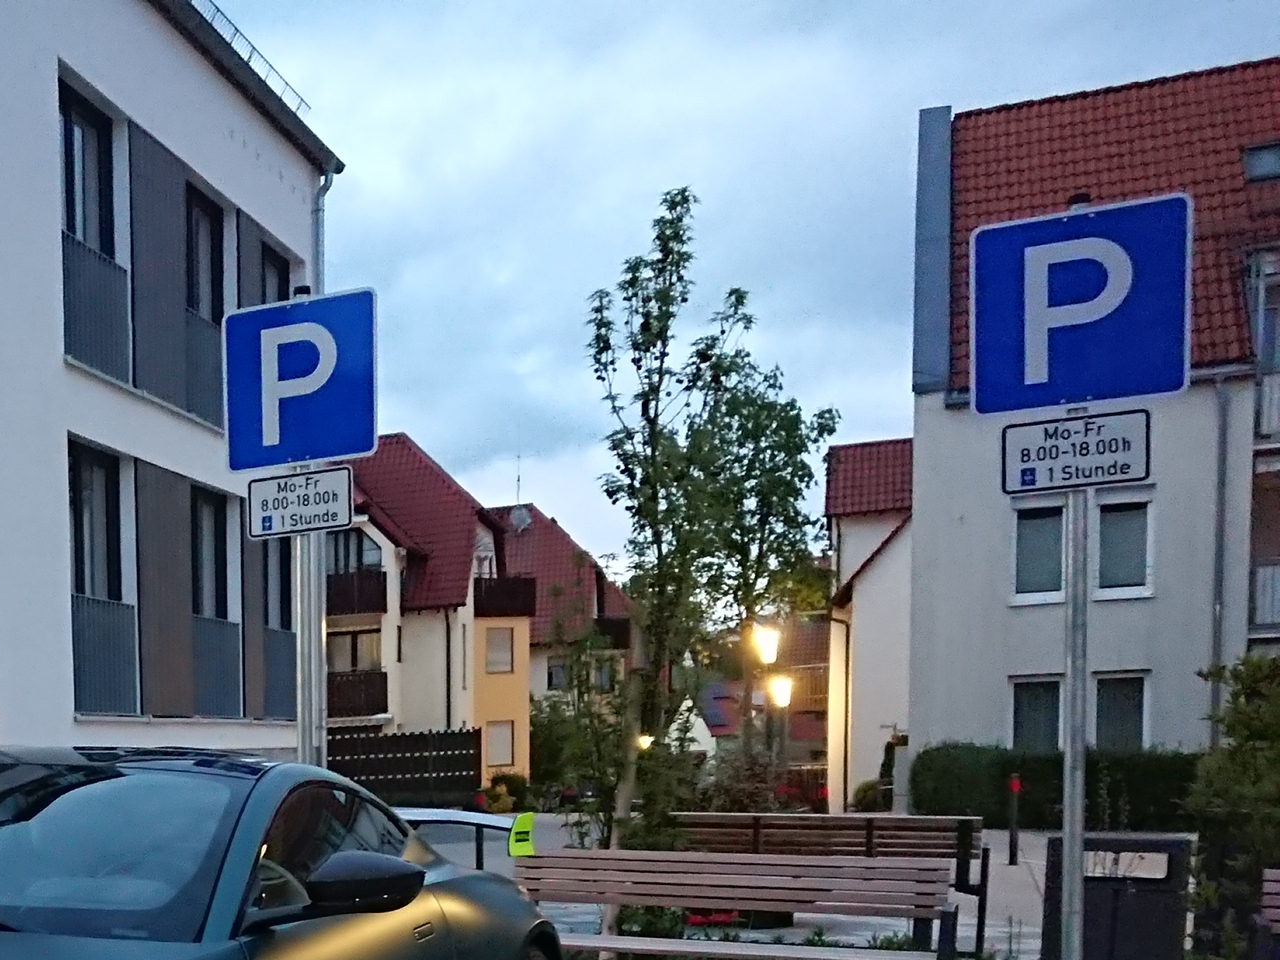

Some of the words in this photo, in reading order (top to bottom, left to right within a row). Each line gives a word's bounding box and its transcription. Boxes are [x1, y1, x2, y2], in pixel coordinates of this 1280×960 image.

[1024, 237, 1133, 385] P
[260, 322, 337, 447] P
[1044, 421, 1105, 442] Mo-Fr
[1048, 467, 1054, 483] 1
[1061, 461, 1131, 481] Stunde
[277, 477, 320, 494] Mo-Fr
[281, 515, 285, 528] 1
[290, 509, 338, 527] Stunde
